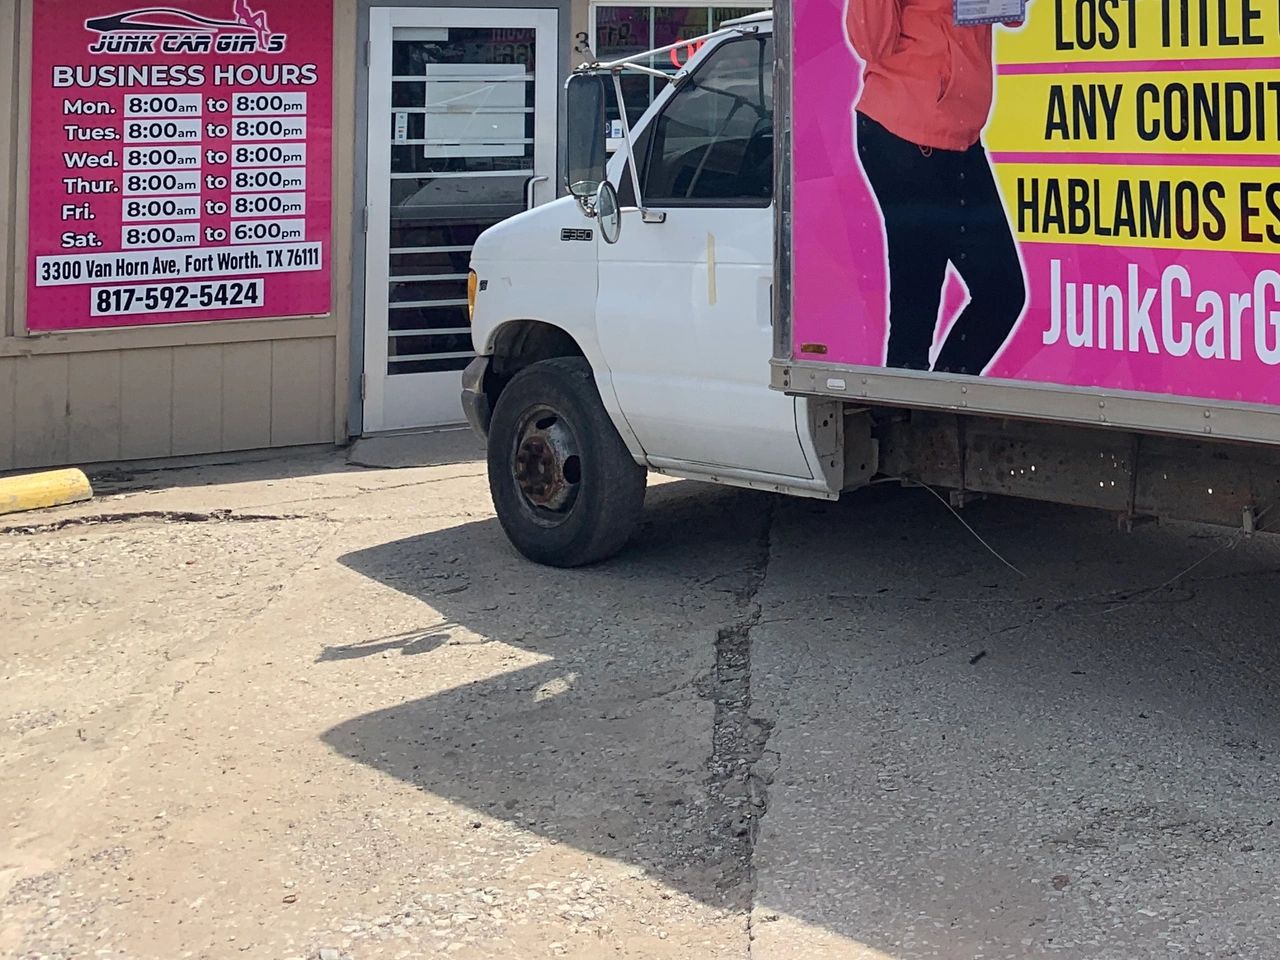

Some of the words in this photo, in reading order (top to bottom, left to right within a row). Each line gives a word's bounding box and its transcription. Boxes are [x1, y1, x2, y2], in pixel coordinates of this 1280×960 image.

[88, 33, 159, 54] JUNK
[161, 33, 212, 54] CAR
[52, 65, 205, 88] BUSINESS
[213, 63, 318, 86] HOURS
[63, 99, 116, 115] Mon.
[129, 98, 198, 113] 8:00am
[206, 98, 229, 113] to
[236, 96, 303, 112] 8:00pm
[1044, 85, 1124, 141] ANY
[64, 125, 120, 140] Tues.
[128, 123, 198, 139] 8:00am
[206, 123, 229, 138] to
[236, 121, 302, 137] 8:00pm
[63, 152, 119, 168] Wed.
[128, 149, 197, 165] 8:00am
[206, 149, 228, 165] to
[235, 147, 302, 163] 8:00pm
[64, 178, 120, 193] Thur.
[128, 175, 197, 191] 8:00am
[205, 175, 228, 190] to
[235, 172, 302, 188] 8:00pm
[61, 204, 95, 220] Fri.
[127, 201, 196, 216] 8:00am
[205, 199, 227, 215] to
[235, 197, 302, 213] 8:00pm
[1016, 177, 1226, 241] HABLAMOS
[60, 232, 102, 248] Sat.
[126, 228, 195, 244] 8:00am
[204, 226, 227, 241] to
[234, 224, 301, 239] 6:00pm
[42, 259, 82, 281] 3300
[86, 259, 112, 278] Van
[116, 257, 148, 276] Horn
[152, 255, 181, 275] Ave,
[185, 253, 213, 272] Fort
[266, 249, 283, 267] TX
[287, 247, 318, 266] 76111
[96, 282, 258, 312] 817-592-5424
